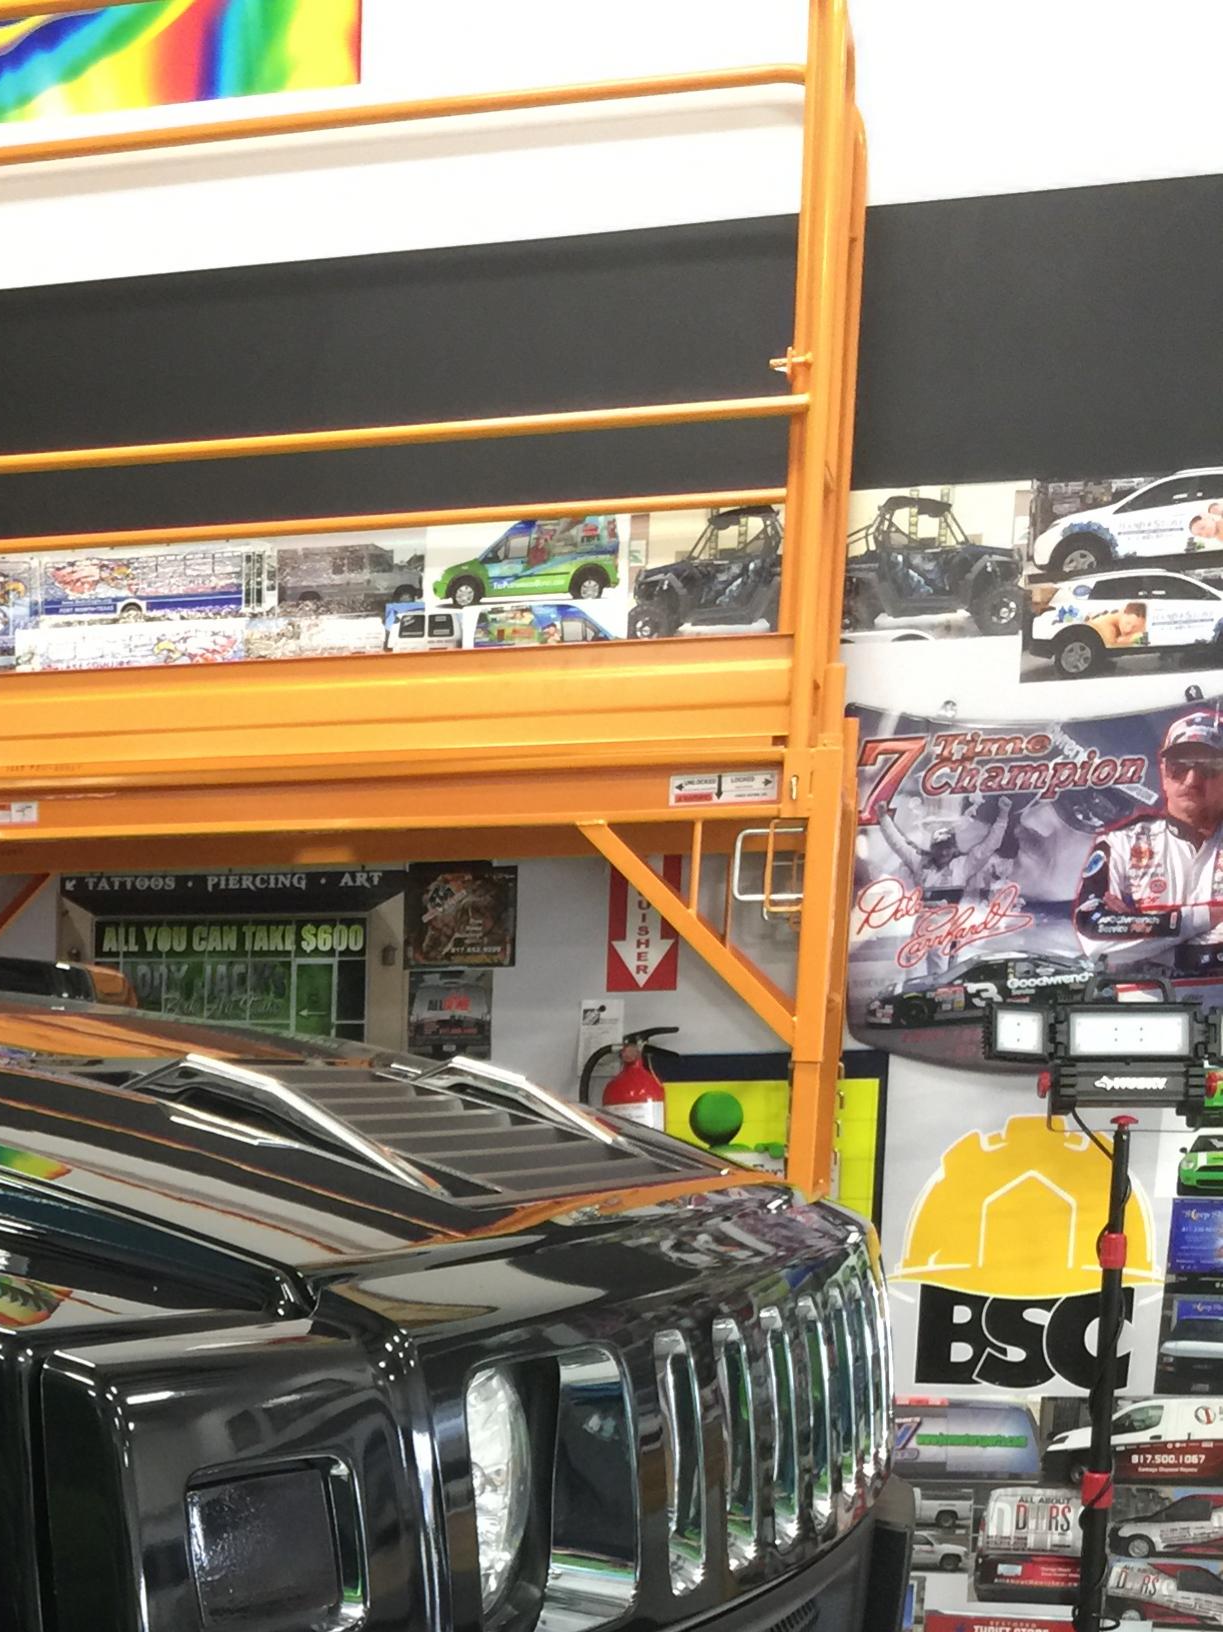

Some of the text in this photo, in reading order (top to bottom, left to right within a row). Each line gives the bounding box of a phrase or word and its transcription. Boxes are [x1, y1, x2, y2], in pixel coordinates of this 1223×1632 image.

[858, 736, 926, 826] 7
[934, 731, 1053, 762] Time
[923, 750, 1146, 801] Champion
[84, 871, 383, 893] TATTOOS PIERCING ART
[102, 922, 365, 953] ALL YOU CAN TAKE $600
[967, 982, 1003, 1008] 3
[1018, 1496, 1071, 1505] ALL ABOUT
